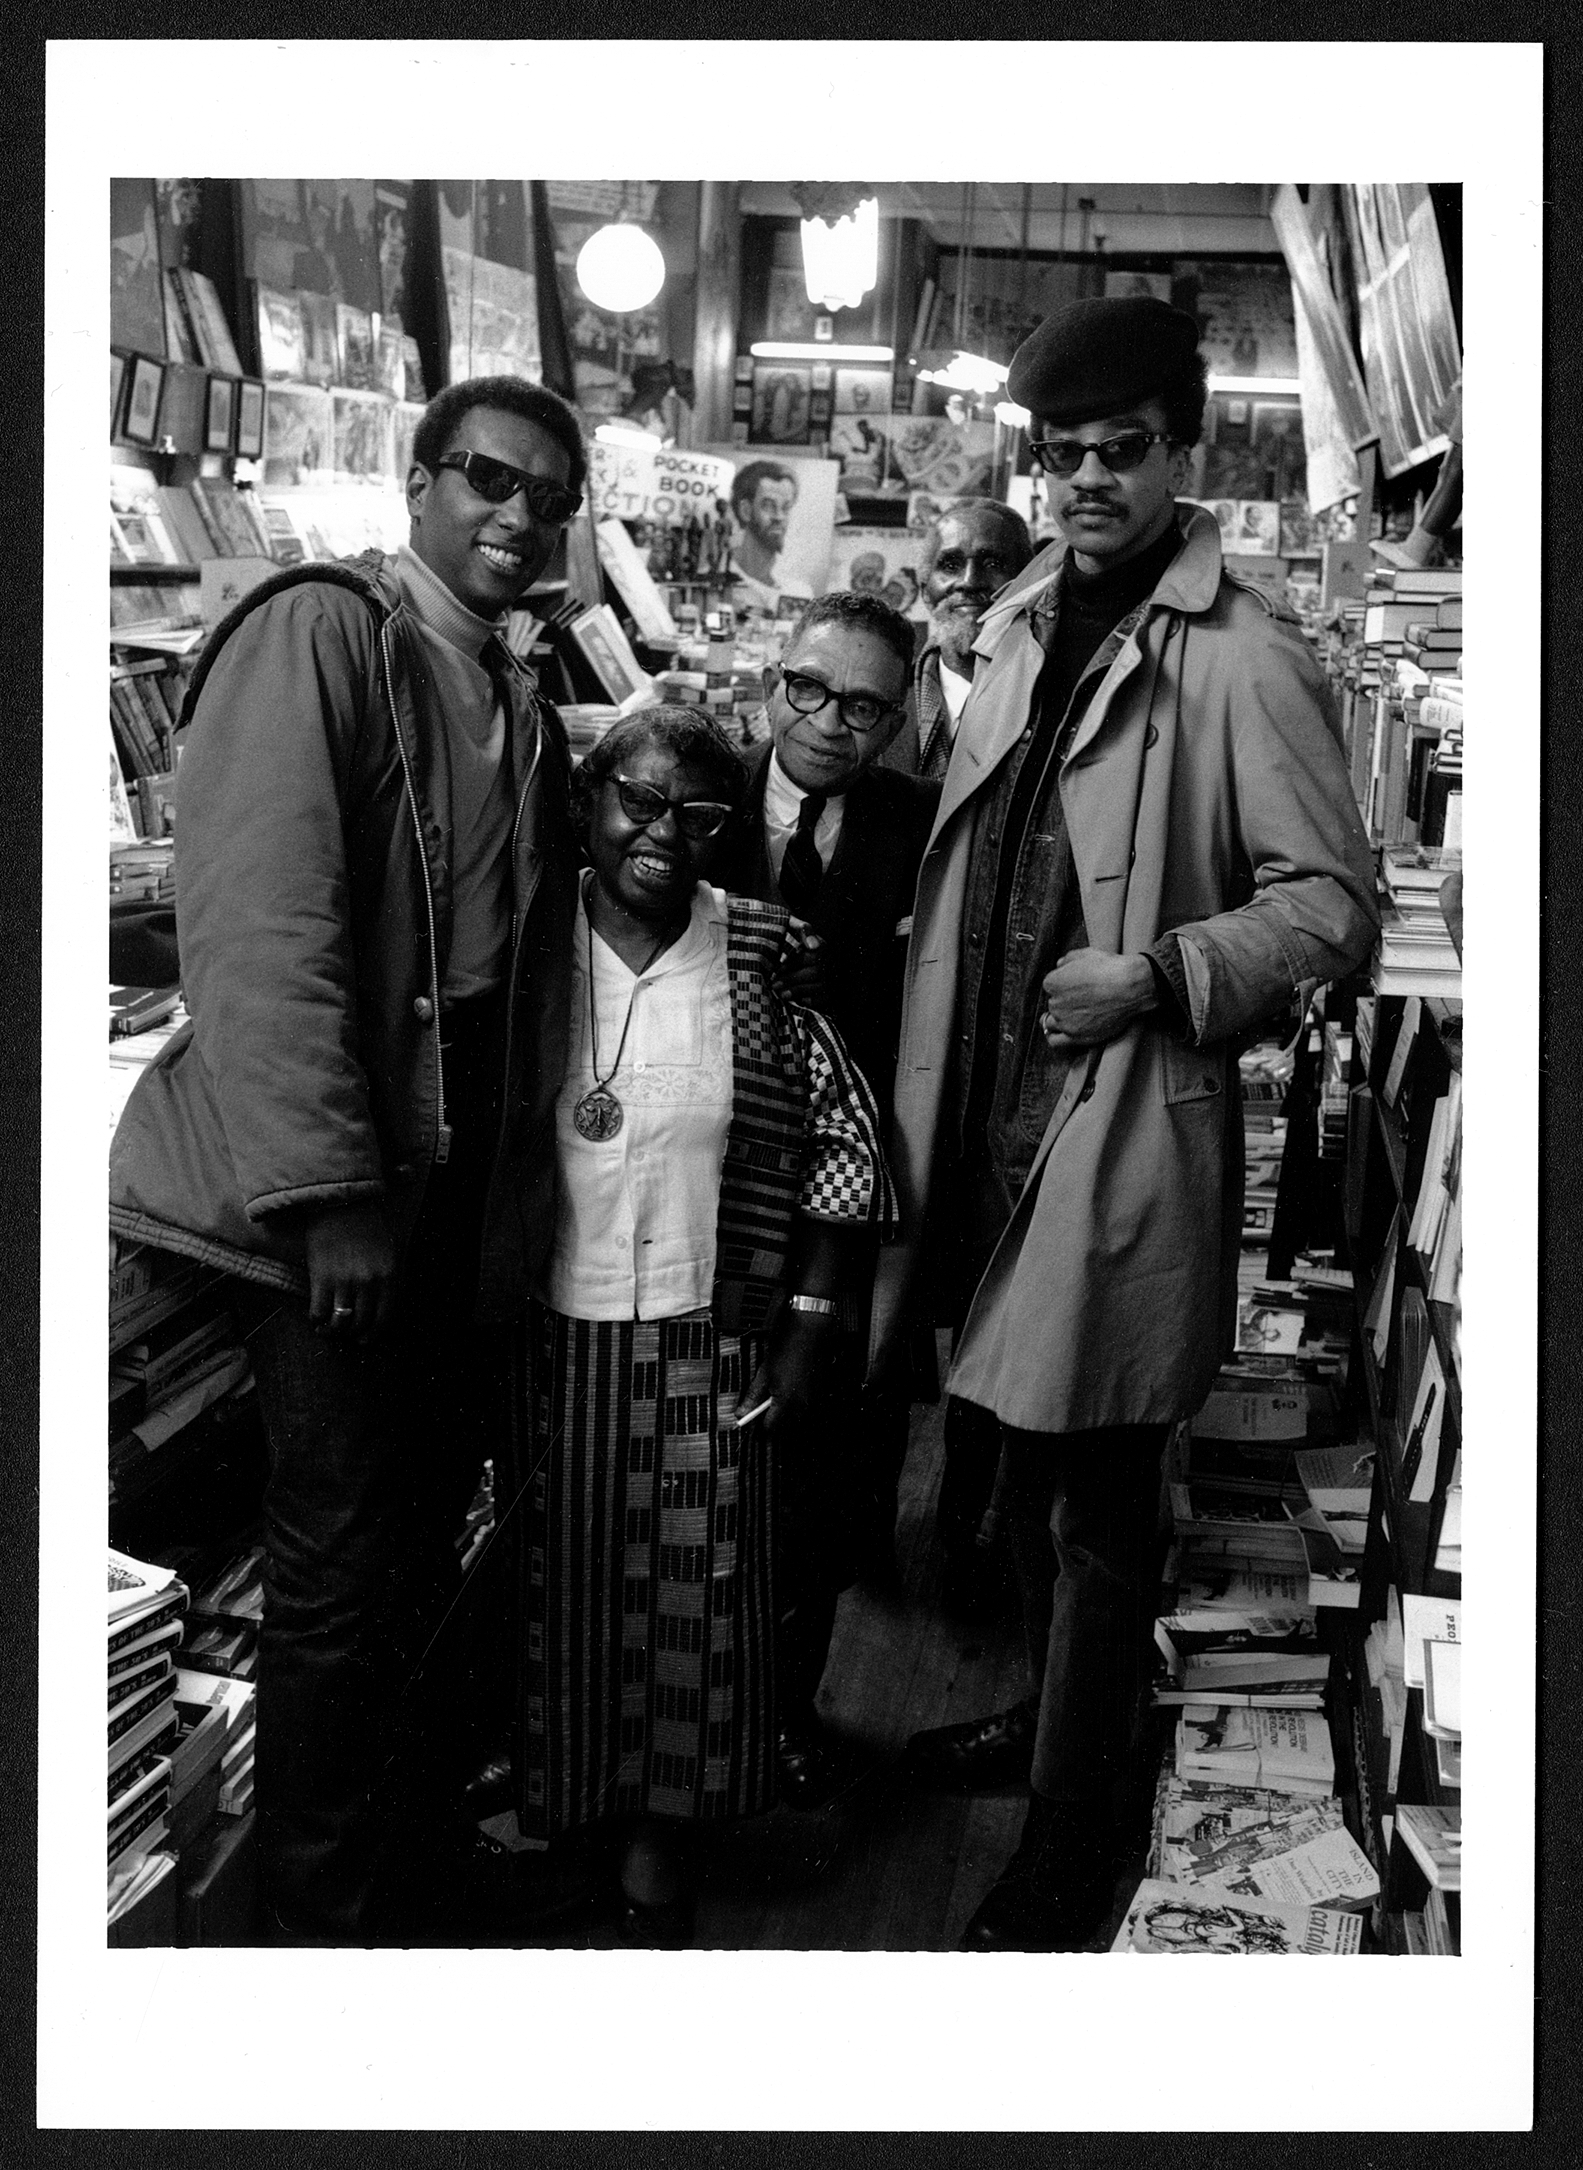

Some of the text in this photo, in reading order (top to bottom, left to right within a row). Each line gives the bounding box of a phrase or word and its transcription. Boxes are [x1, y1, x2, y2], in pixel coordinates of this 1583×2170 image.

[653, 454, 719, 478] POCKET
[659, 475, 719, 500] BOOK
[1446, 1614, 1456, 1642] PEO
[1349, 1848, 1374, 1881] ISLAND
[1326, 1869, 1345, 1890] CITY
[1339, 1868, 1355, 1886] THE
[1352, 1872, 1364, 1884] IN
